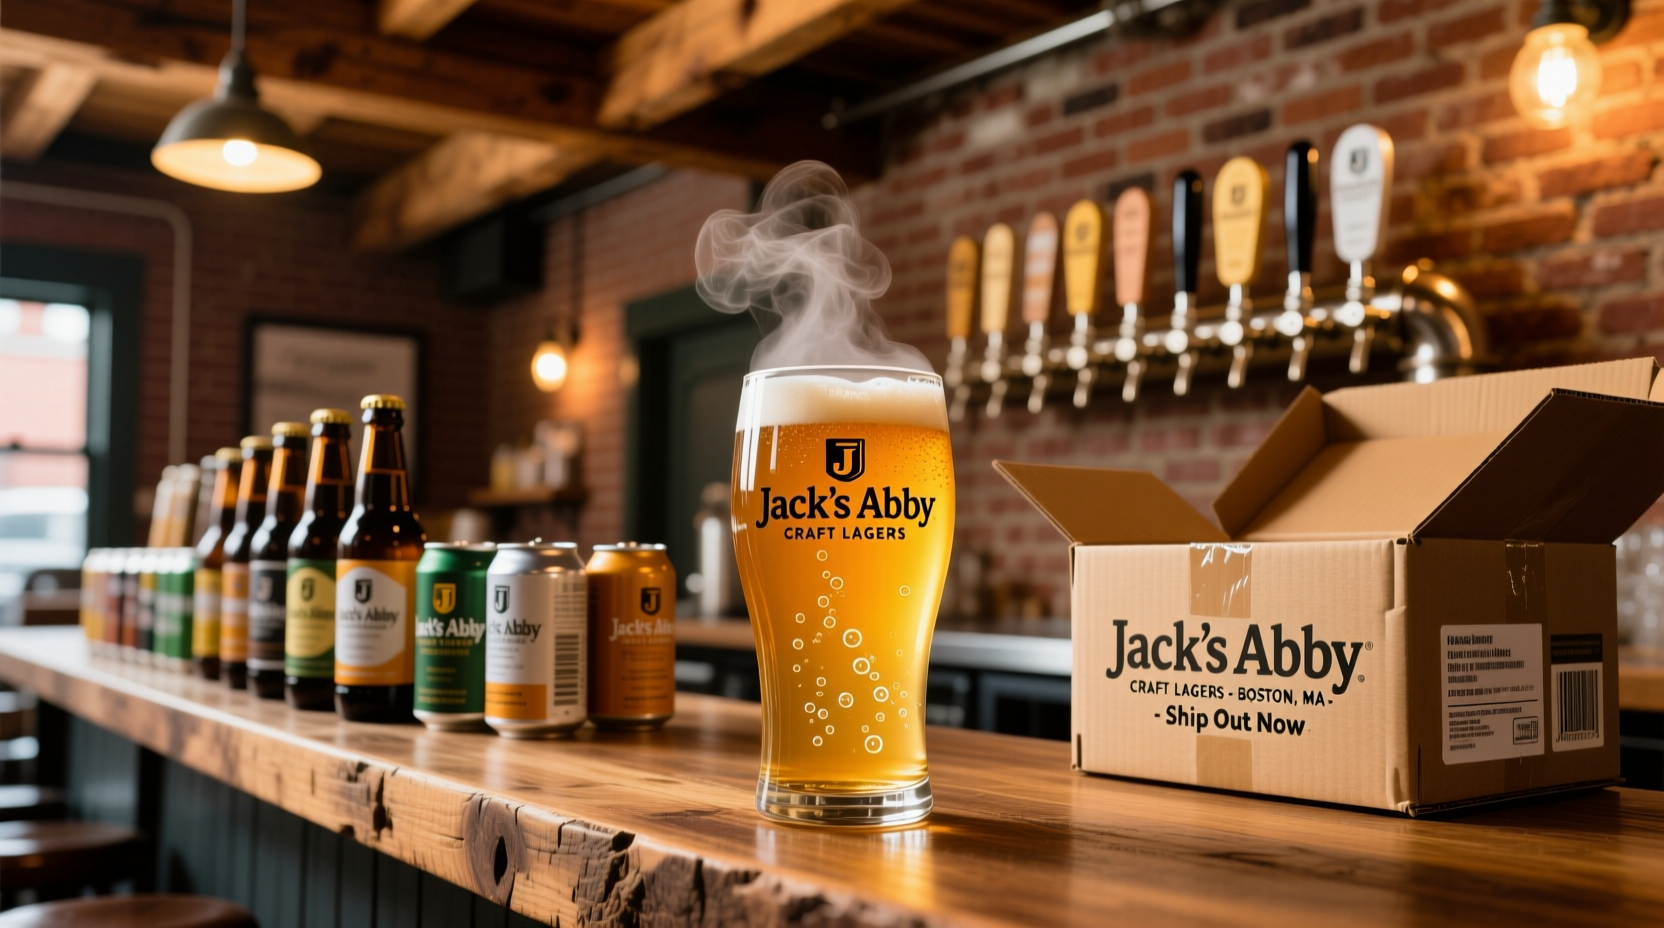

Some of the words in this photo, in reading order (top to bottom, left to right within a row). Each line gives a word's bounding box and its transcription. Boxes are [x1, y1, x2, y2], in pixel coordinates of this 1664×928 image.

[756, 486, 850, 528] Jack's
[856, 486, 935, 527] Abby
[784, 527, 836, 540] CRAFT
[842, 527, 906, 540] LAGERS
[445, 617, 486, 644] Abby
[504, 619, 542, 642] Abby
[1106, 619, 1228, 679] Jack's
[1233, 623, 1364, 695] Abby
[1130, 680, 1169, 695] CRAFT
[1174, 683, 1224, 699] LAGERS
[1238, 687, 1298, 706] BOSTON,
[1166, 705, 1208, 733] Ship
[1213, 708, 1252, 731] Out
[1257, 711, 1306, 736] Now
